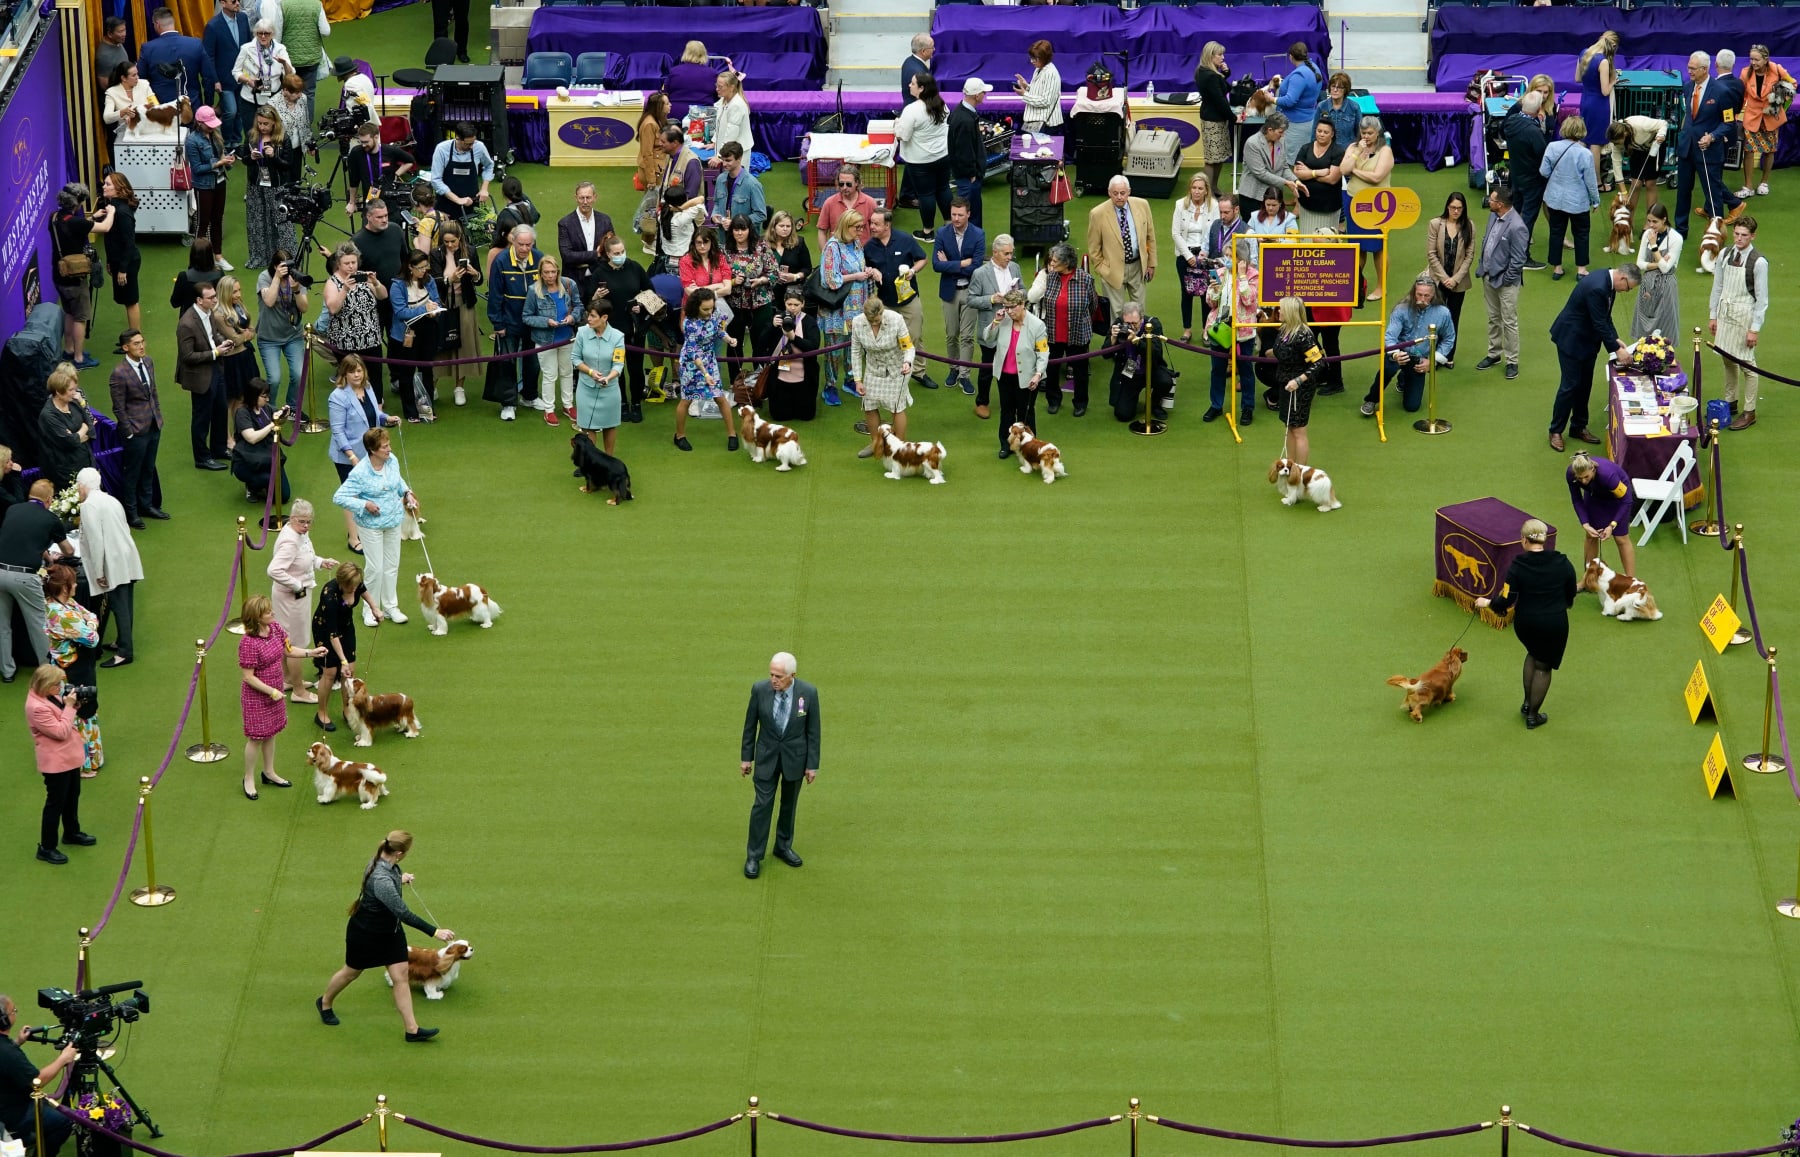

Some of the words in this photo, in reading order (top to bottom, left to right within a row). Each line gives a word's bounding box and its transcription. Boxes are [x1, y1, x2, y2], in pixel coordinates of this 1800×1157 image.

[2, 159, 48, 267] WESTMINSTER
[1374, 190, 1396, 226] 9
[1292, 249, 1326, 258] JUDGE
[1710, 607, 1718, 618] OF
[1715, 598, 1726, 614] BEST
[1703, 616, 1716, 635] BREED
[1707, 752, 1718, 784] SELECT
